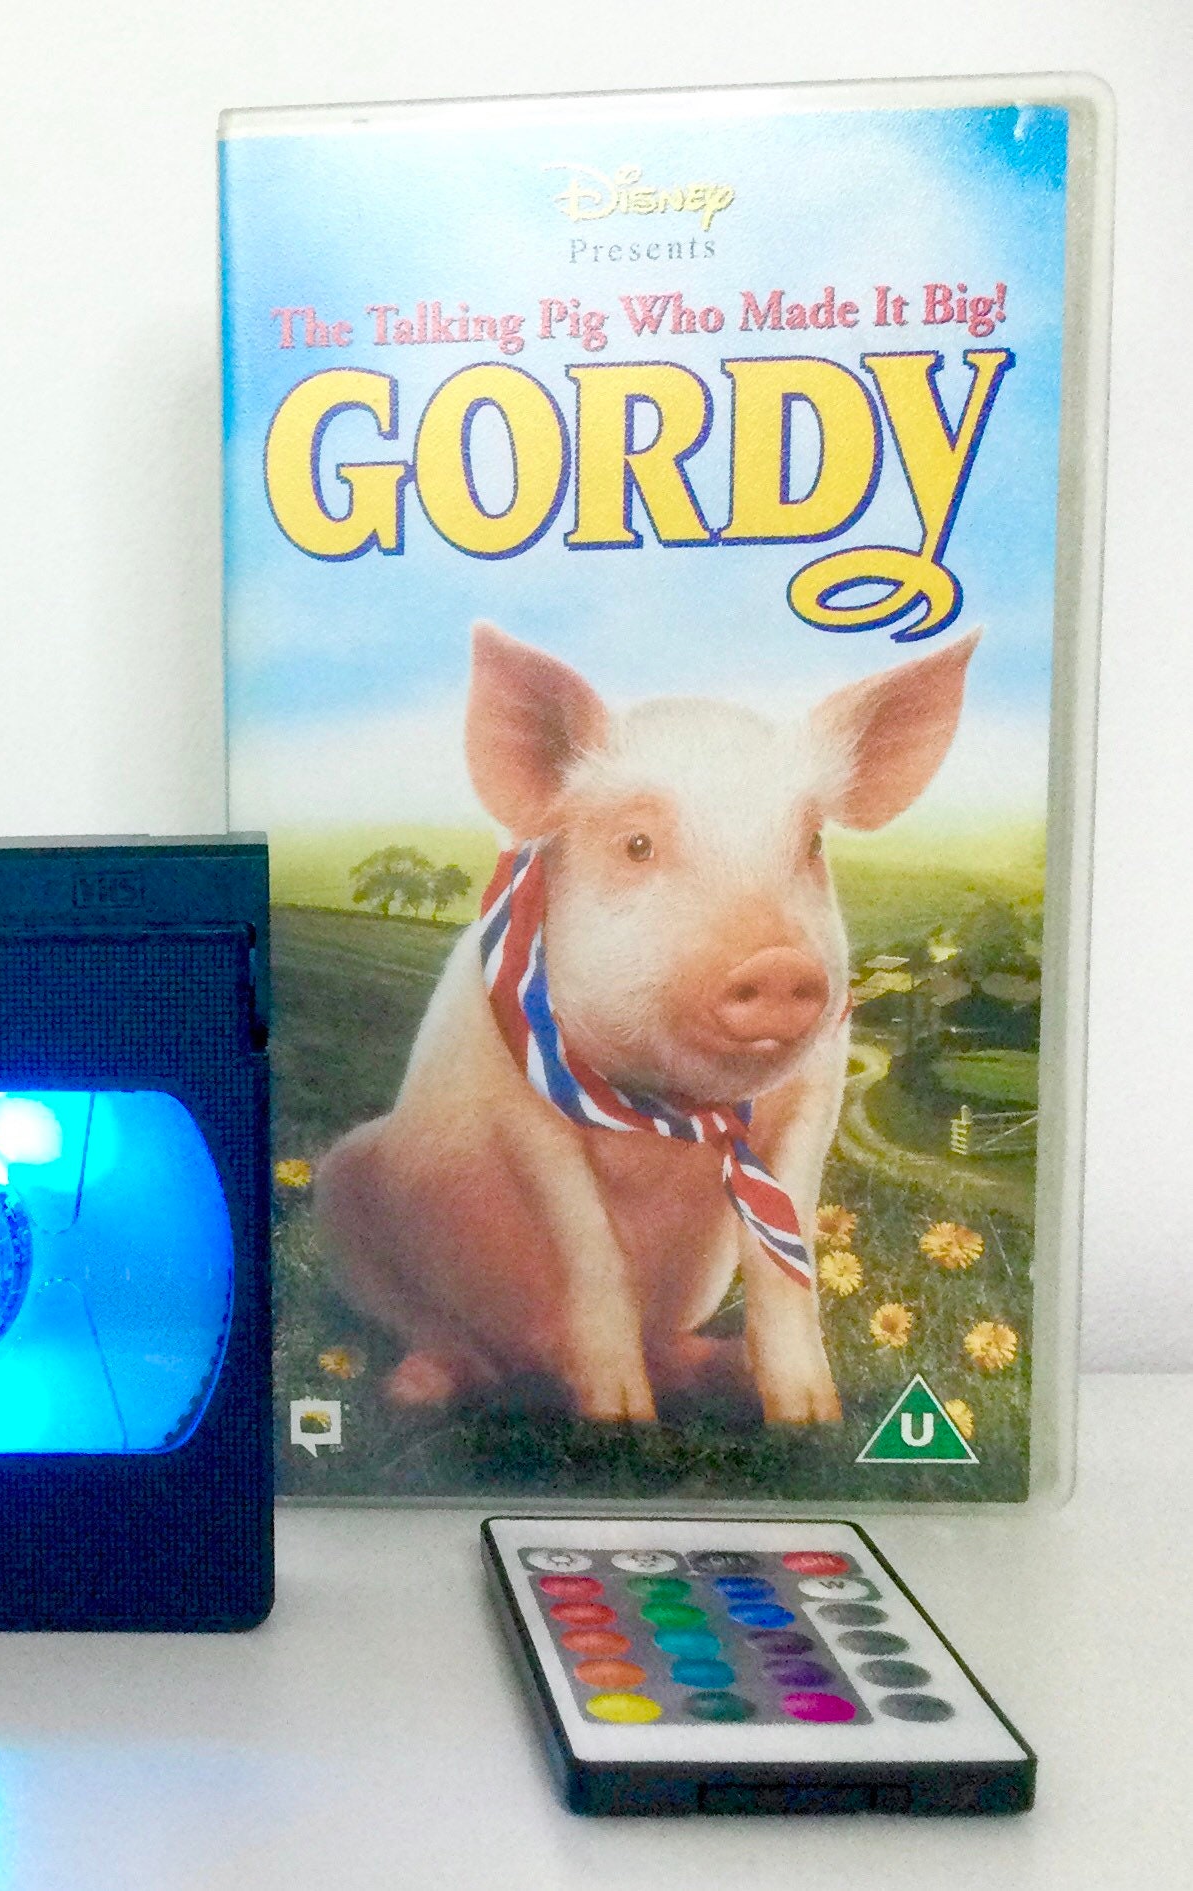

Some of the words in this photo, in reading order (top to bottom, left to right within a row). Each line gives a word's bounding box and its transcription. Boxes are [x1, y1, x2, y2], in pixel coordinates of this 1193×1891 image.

[569, 237, 716, 264] Presents
[270, 305, 354, 349] The
[364, 301, 525, 355] Talking
[538, 298, 609, 352] Pig
[619, 290, 725, 337] Who
[739, 285, 859, 332] Made
[874, 284, 908, 327] It
[921, 282, 1008, 338] Big!
[263, 348, 1015, 642] GORDY
[901, 1412, 934, 1447] U
